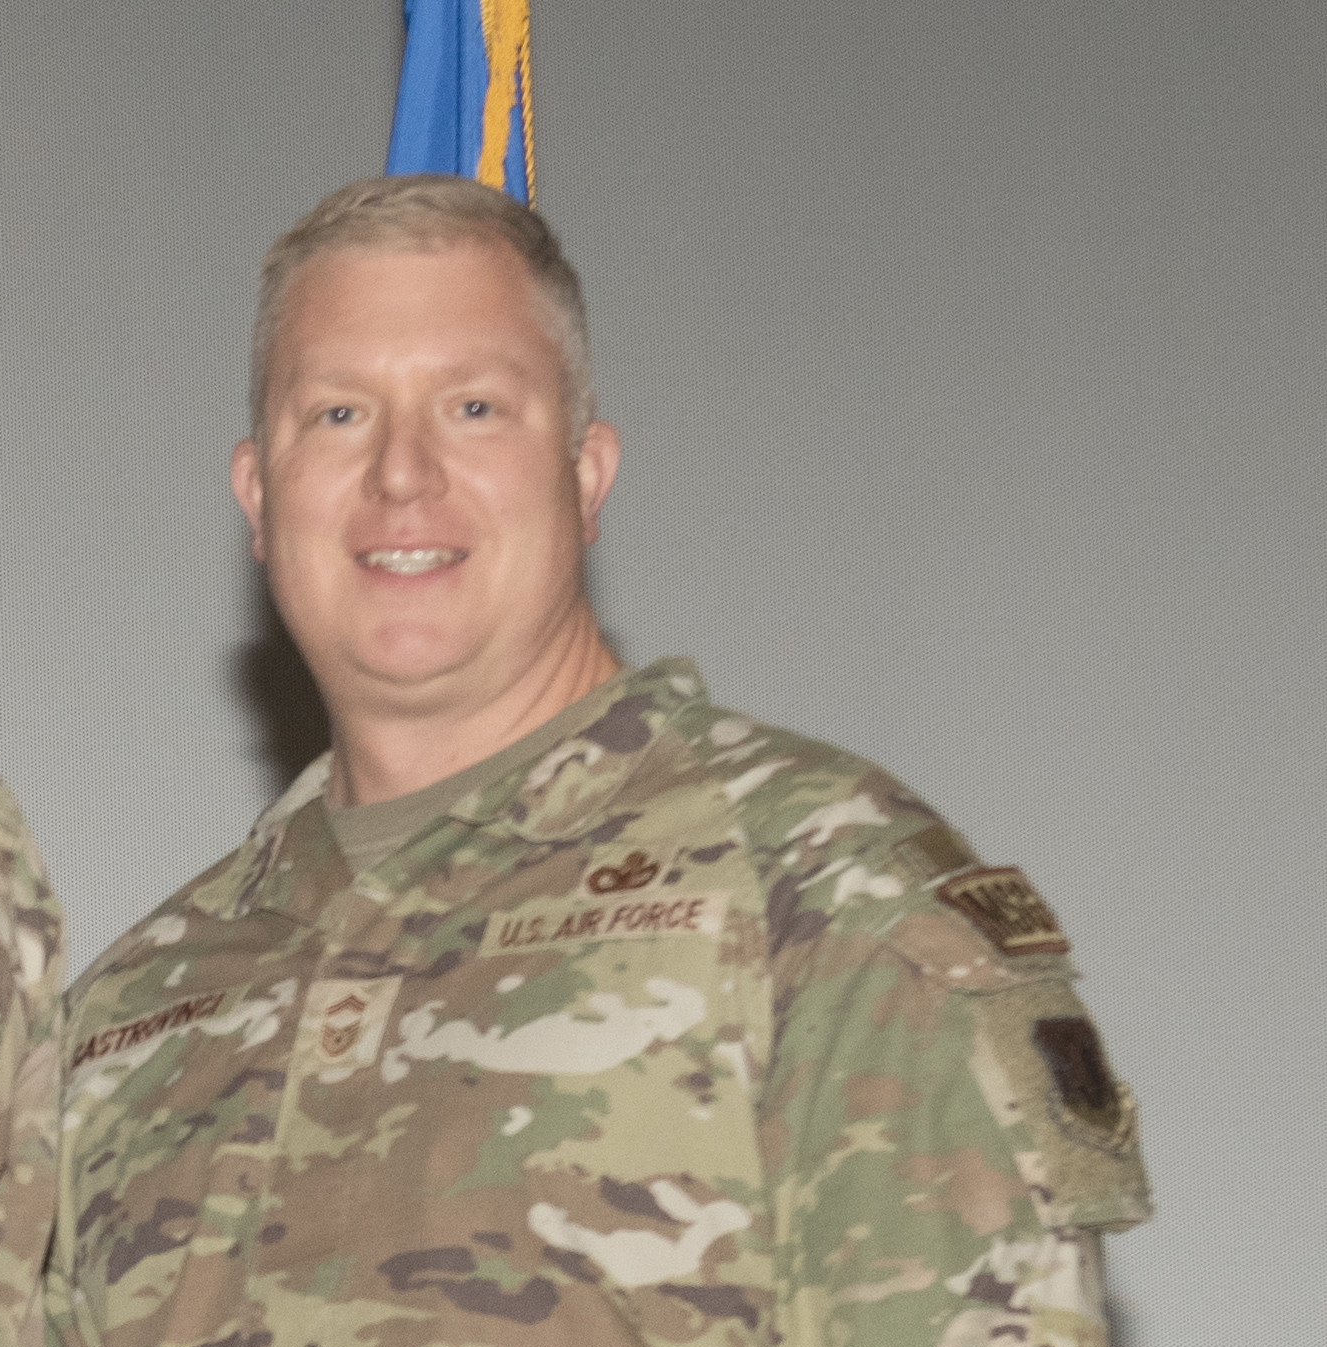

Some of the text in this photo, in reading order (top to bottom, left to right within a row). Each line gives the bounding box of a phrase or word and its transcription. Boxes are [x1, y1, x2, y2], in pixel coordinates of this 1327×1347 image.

[499, 899, 706, 949] U.S. AIR FORCE
